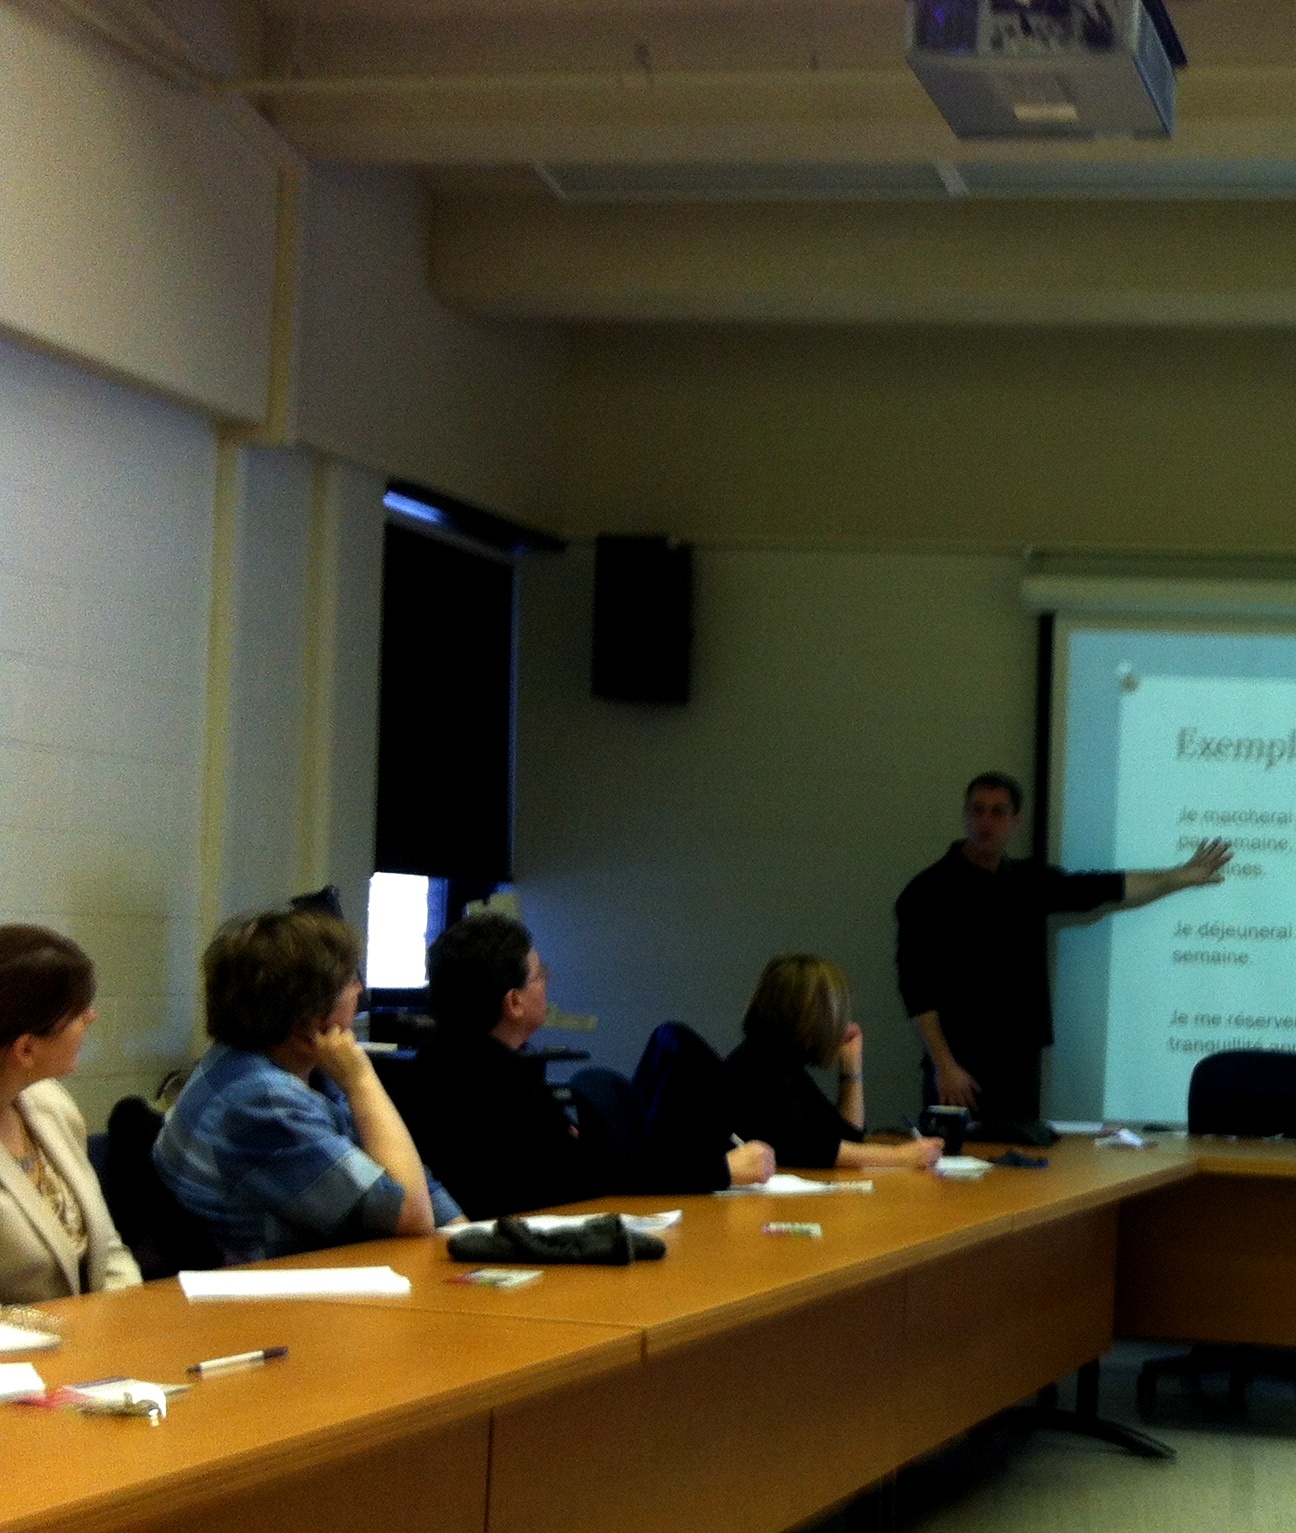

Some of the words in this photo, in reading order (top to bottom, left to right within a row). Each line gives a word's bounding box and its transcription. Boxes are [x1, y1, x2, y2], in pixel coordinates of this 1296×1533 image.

[1204, 809, 1293, 825] marcherai
[1175, 921, 1192, 936] Je
[1198, 921, 1293, 941] déjeunerai
[1170, 1010, 1189, 1025] Je
[1194, 1012, 1222, 1027] me
